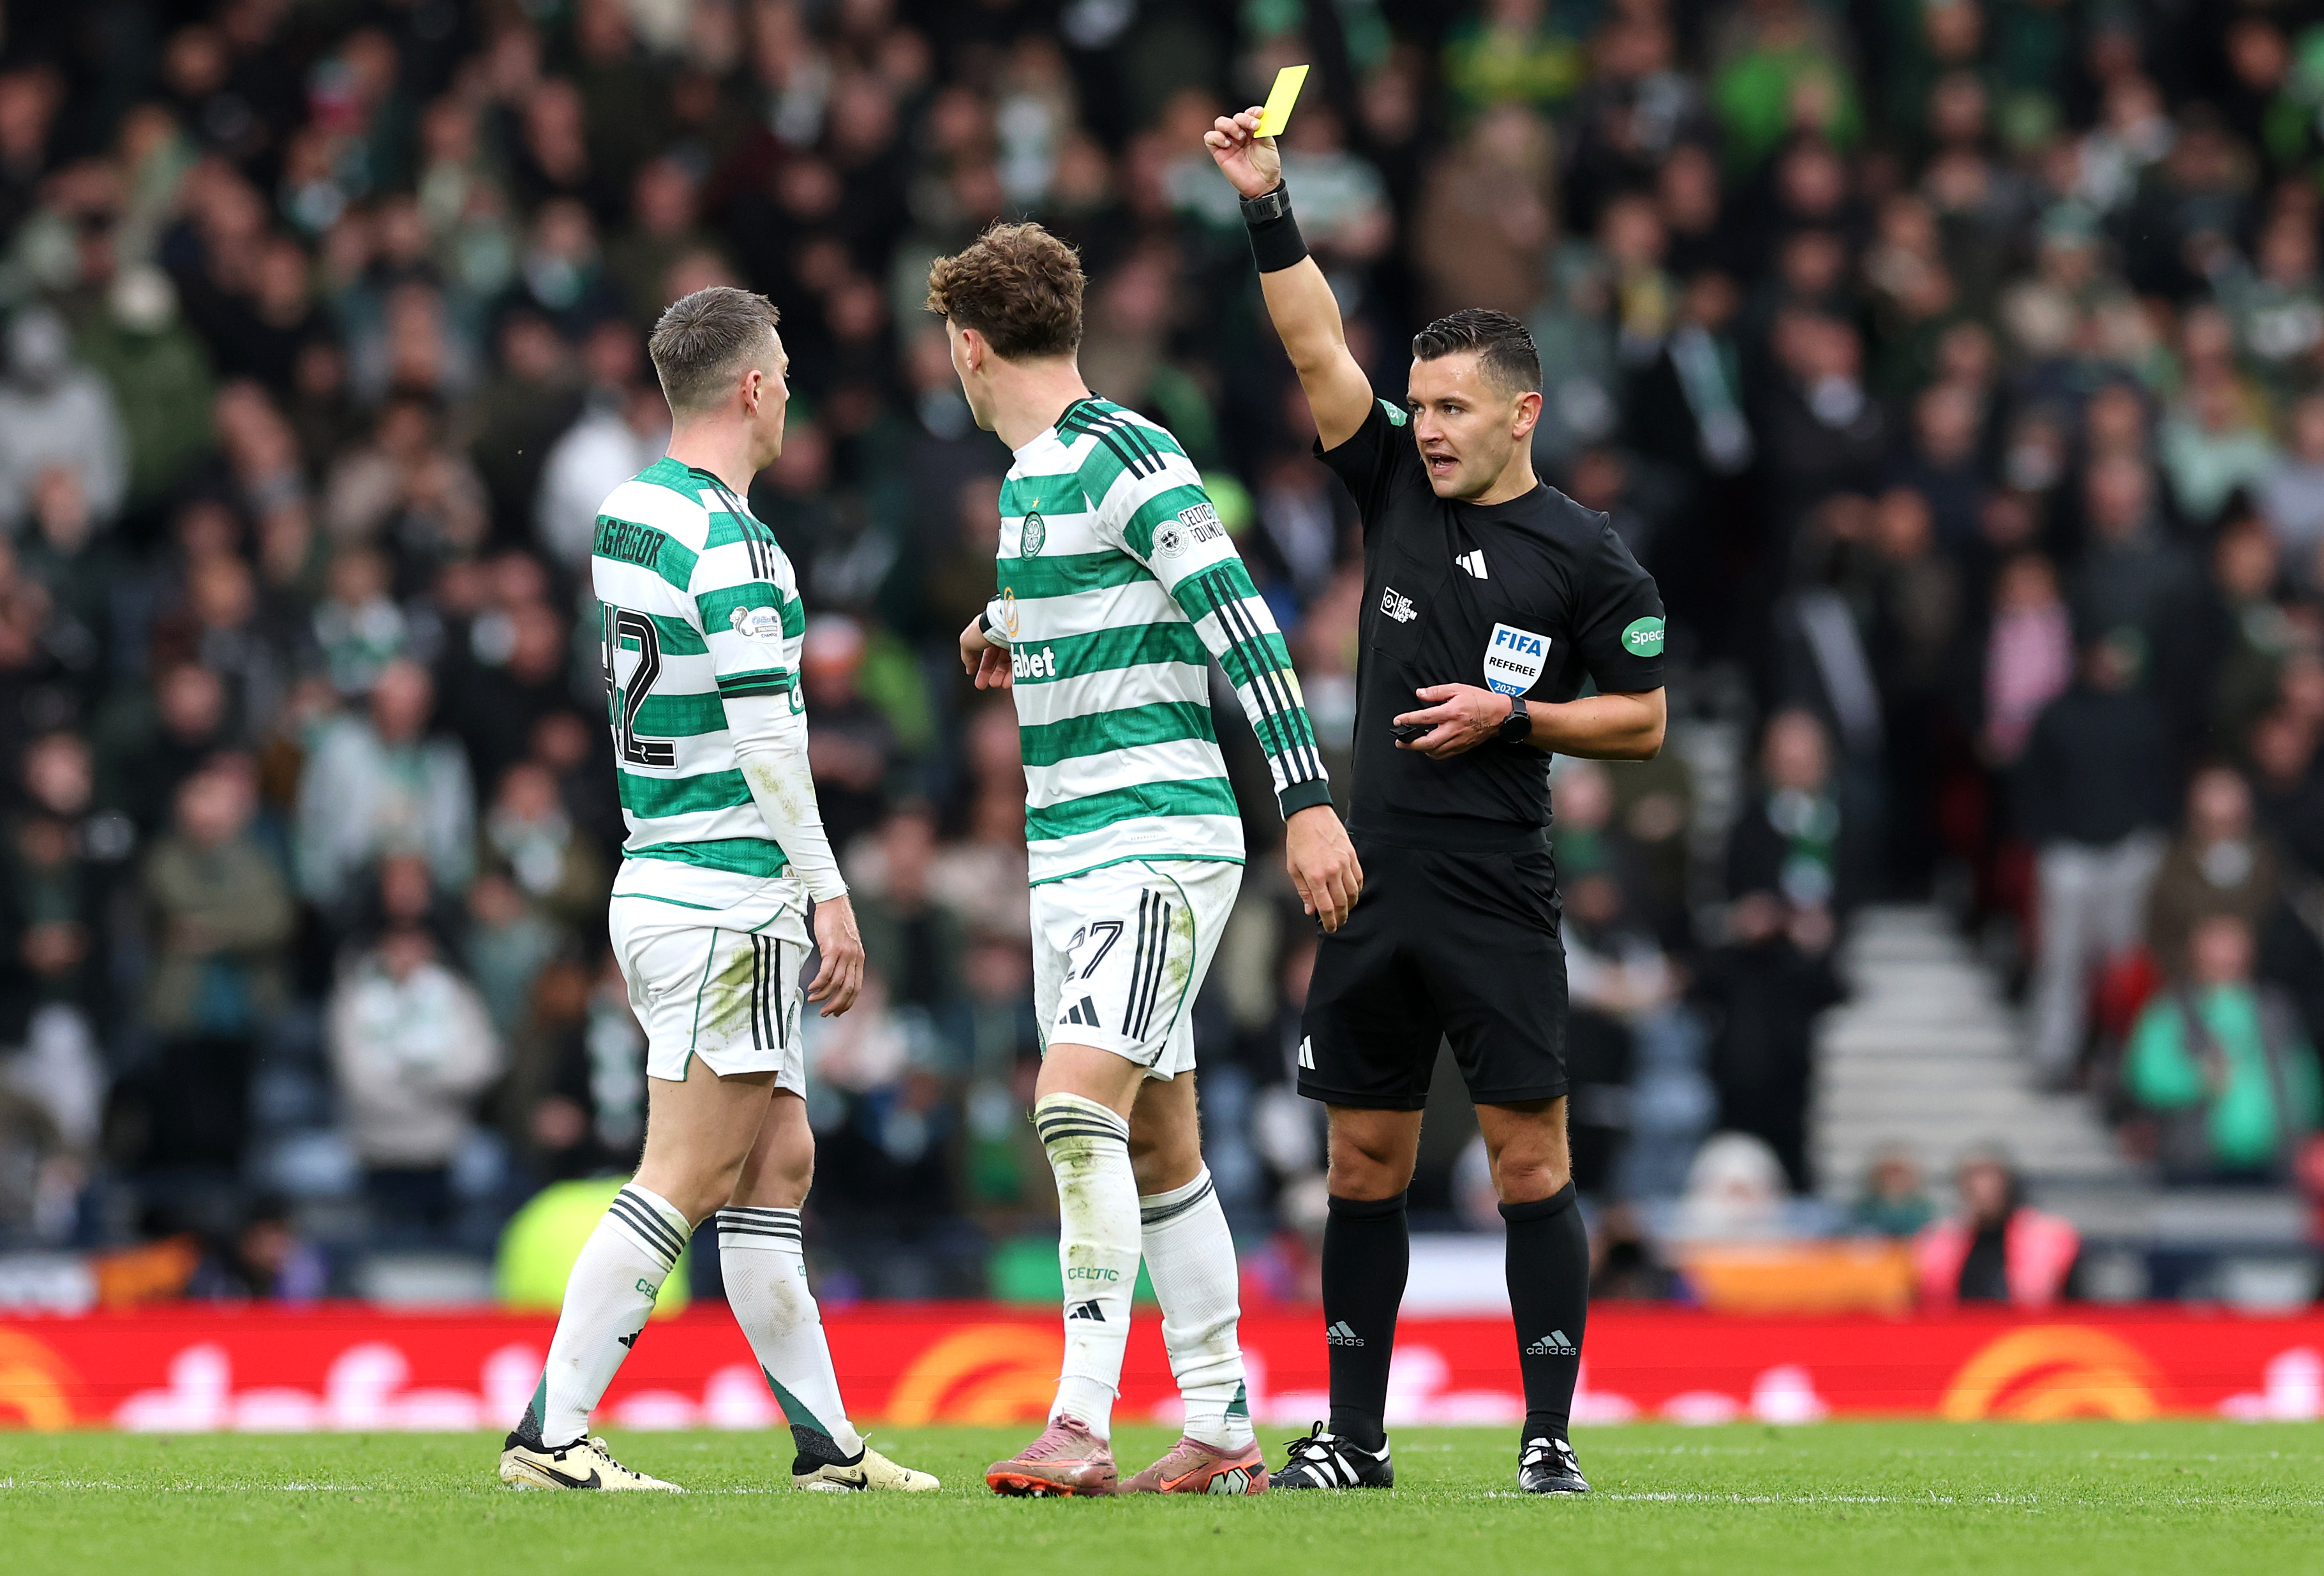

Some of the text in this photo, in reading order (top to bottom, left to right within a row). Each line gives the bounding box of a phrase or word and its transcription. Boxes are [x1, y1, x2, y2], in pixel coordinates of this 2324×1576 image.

[1179, 504, 1212, 528] CELTIC
[1495, 629, 1541, 657] FIFA
[1011, 643, 1056, 684] abet
[1489, 657, 1537, 677] REFEREE
[1494, 683, 1517, 695] 2025
[1068, 1267, 1119, 1282] CELTIC
[1526, 1345, 1577, 1356] adidas
